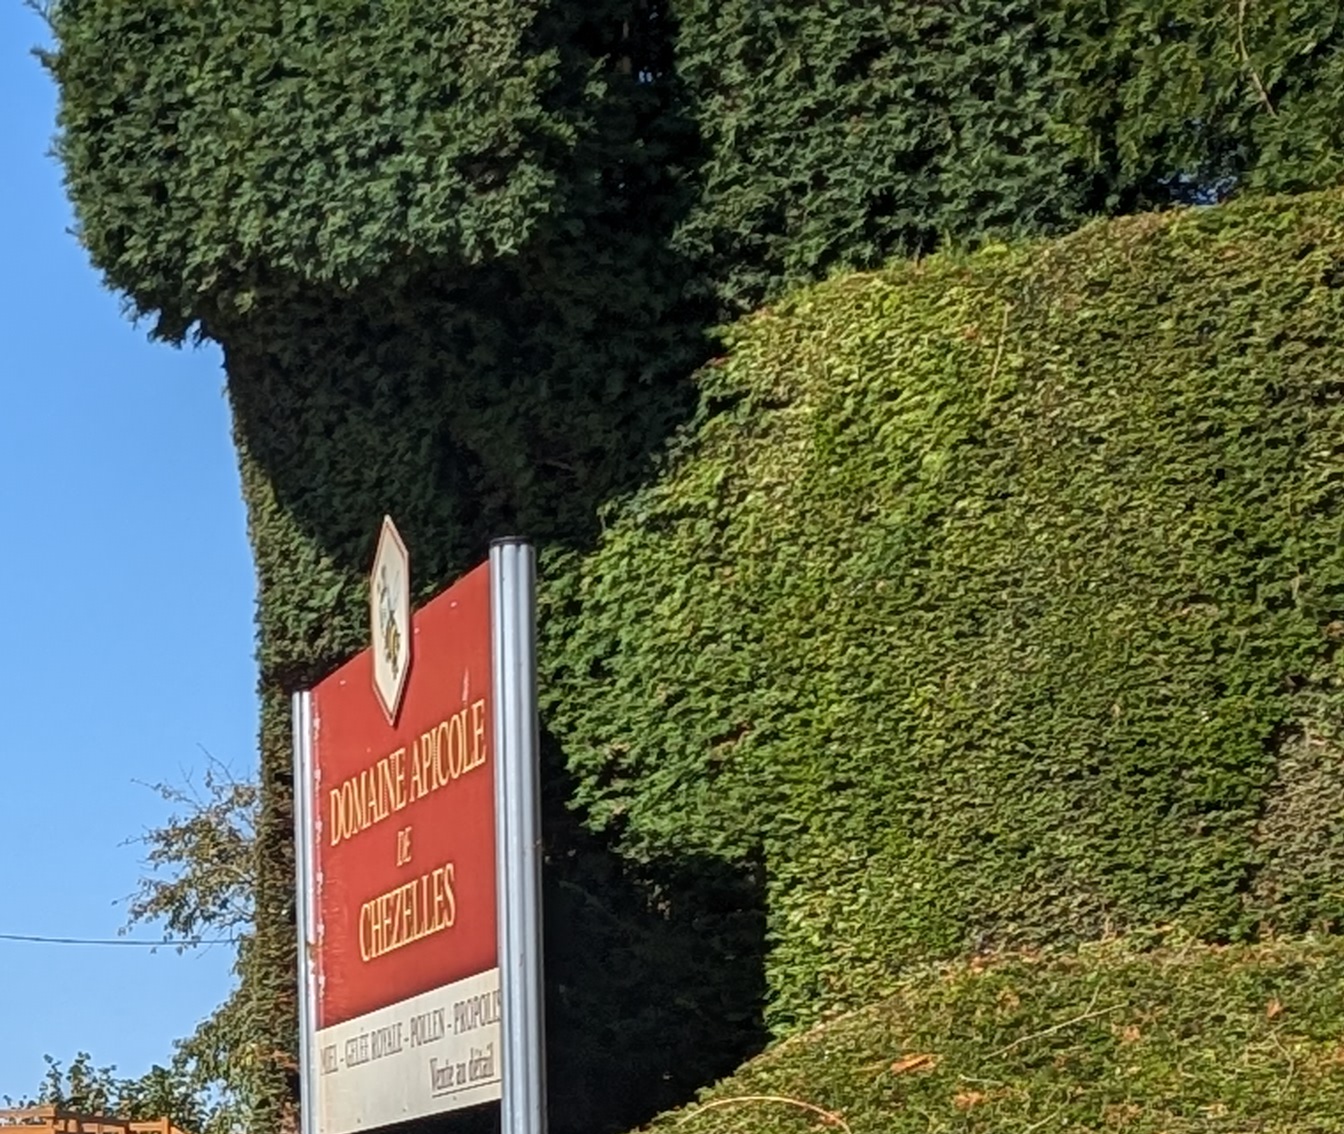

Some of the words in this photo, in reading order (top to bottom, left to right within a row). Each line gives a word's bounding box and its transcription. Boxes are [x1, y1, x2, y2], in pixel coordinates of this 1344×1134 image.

[330, 748, 408, 847] DOMAINE
[409, 699, 487, 802] APICOLE
[396, 826, 412, 867] DE
[359, 863, 456, 961] CHEZELLES
